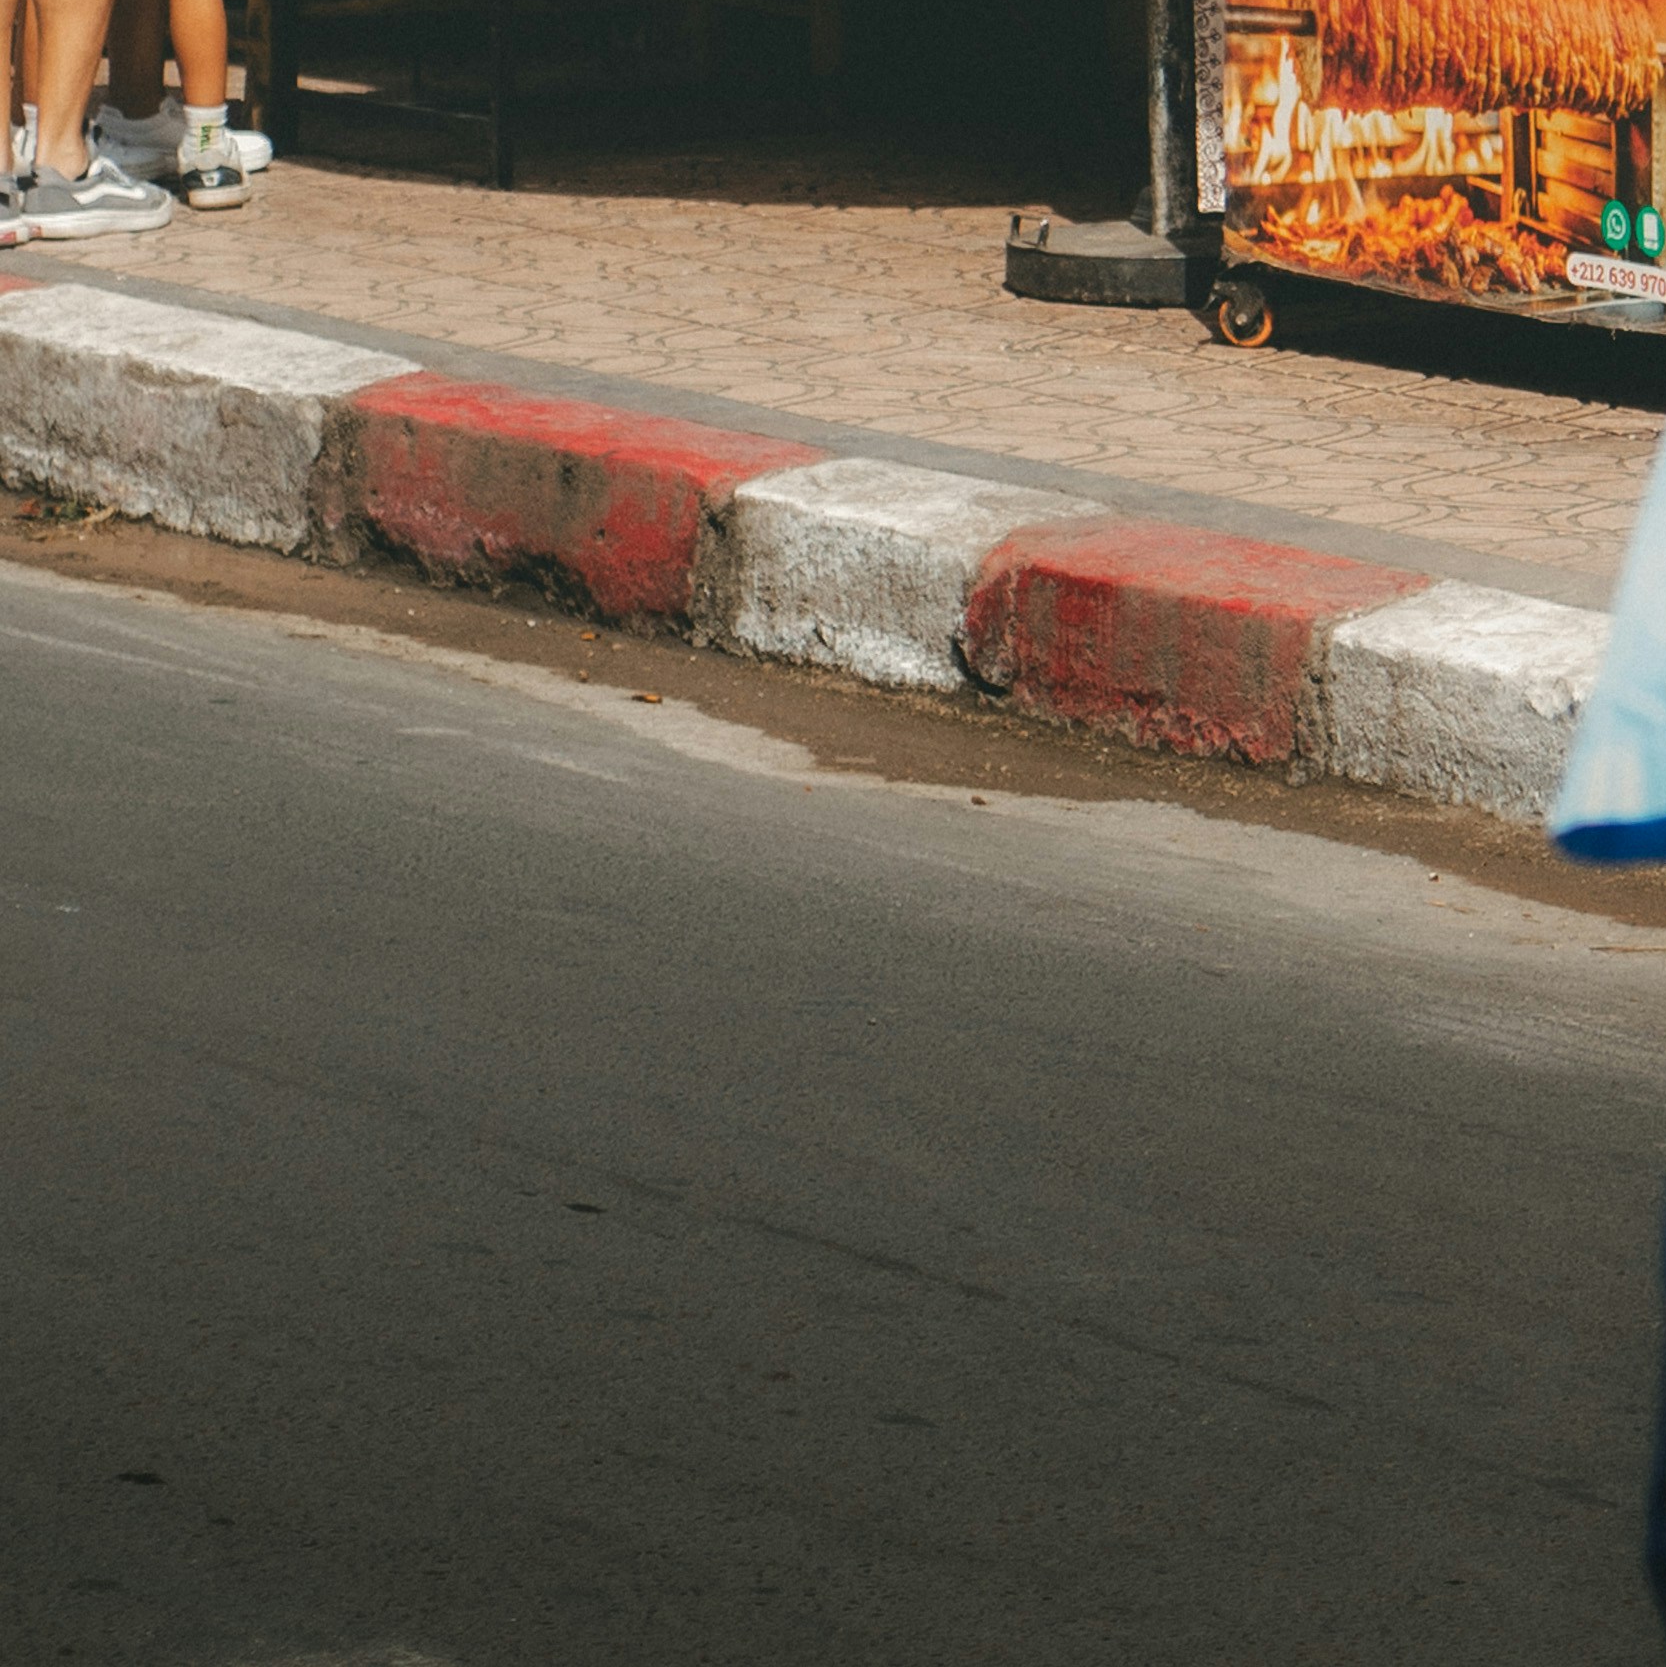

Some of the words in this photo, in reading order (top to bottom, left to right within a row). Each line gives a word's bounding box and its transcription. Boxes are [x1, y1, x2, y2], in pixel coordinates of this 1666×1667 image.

[1570, 261, 1605, 284] +212
[1609, 267, 1636, 290] 639
[1640, 273, 1666, 297] 970
